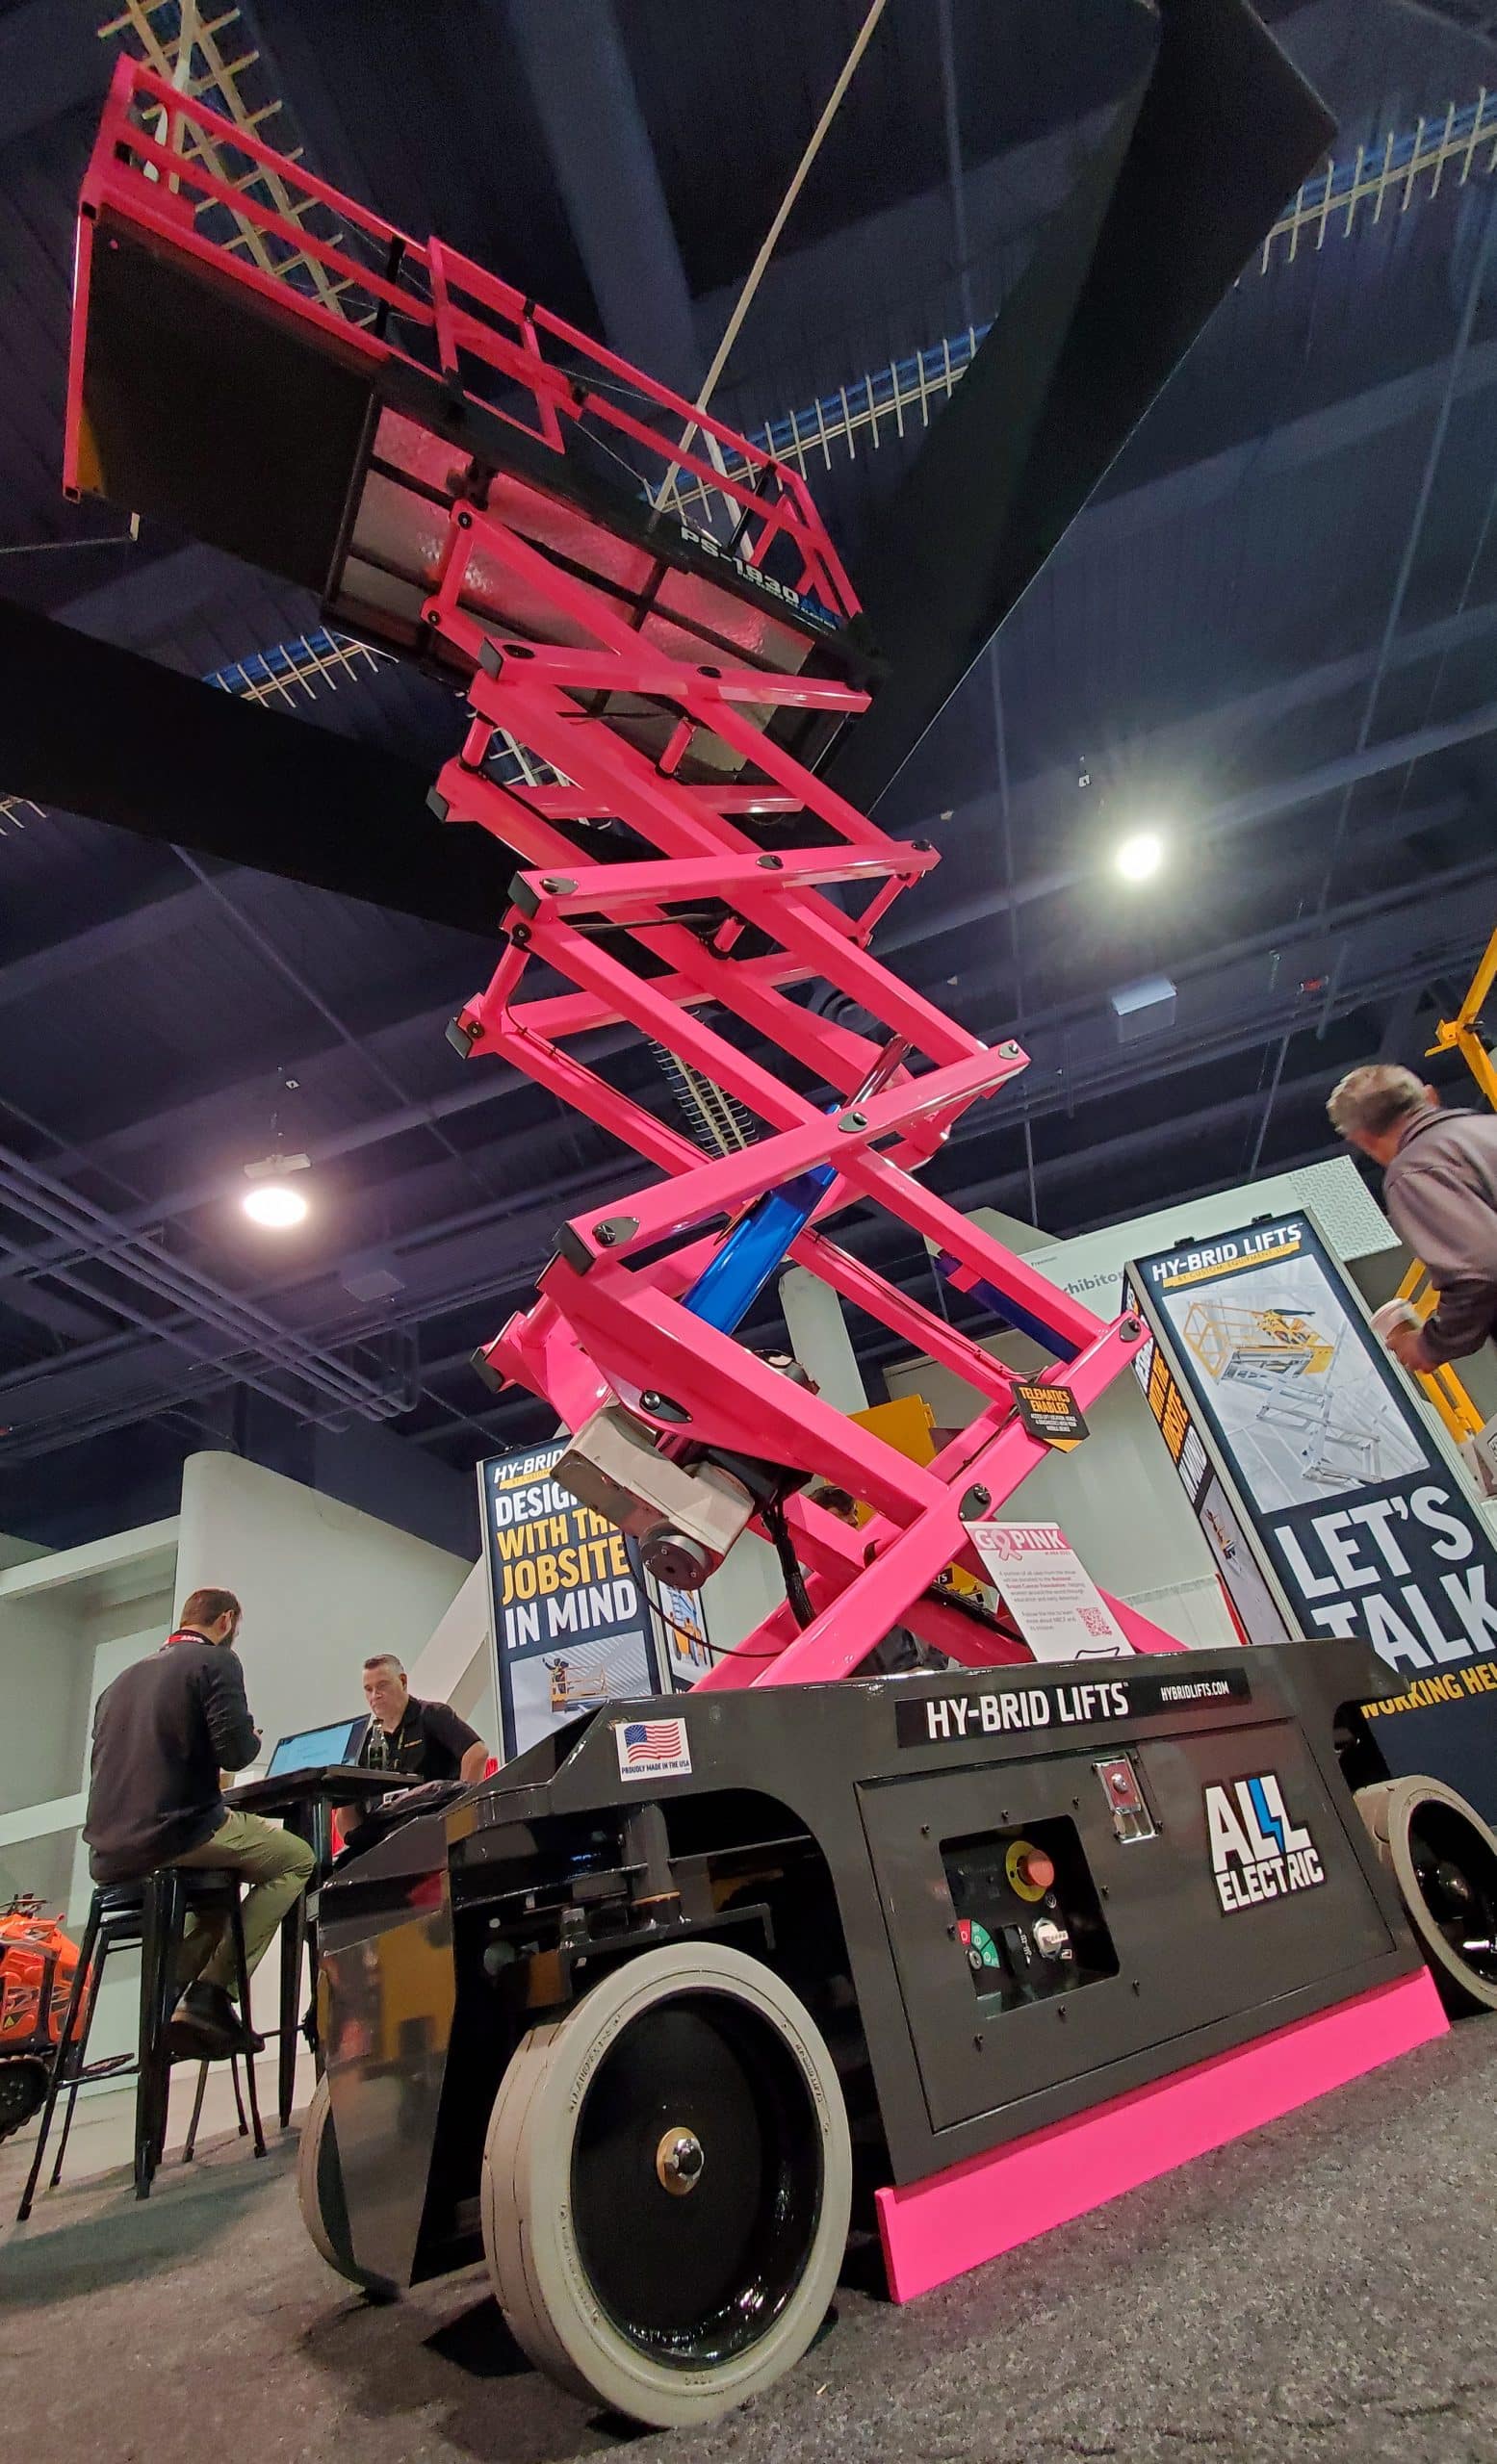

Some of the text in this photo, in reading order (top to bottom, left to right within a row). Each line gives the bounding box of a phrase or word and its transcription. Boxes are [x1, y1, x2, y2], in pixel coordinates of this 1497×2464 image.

[1151, 1243, 1238, 1281] HY-BRID
[1019, 1386, 1071, 1403] TELEMATICS
[1030, 1399, 1070, 1415] ENABLED
[497, 1513, 569, 1561] WITH
[1009, 1530, 1068, 1550] PINK
[1275, 1486, 1474, 1600] LET'S
[502, 1535, 631, 1605] JOBSITE
[503, 1578, 637, 1649] IN MIND
[1310, 1564, 1497, 1673] TALK
[926, 1690, 1050, 1739] HY-BRID
[1160, 1681, 1230, 1702] HYBRIDLIFTS.COM
[621, 1764, 645, 1775] PROUDLY
[646, 1762, 661, 1772] MADE
[669, 1760, 678, 1769] THE
[1205, 1775, 1312, 1873] ALL
[1215, 1848, 1325, 1912] ELECTRIC
